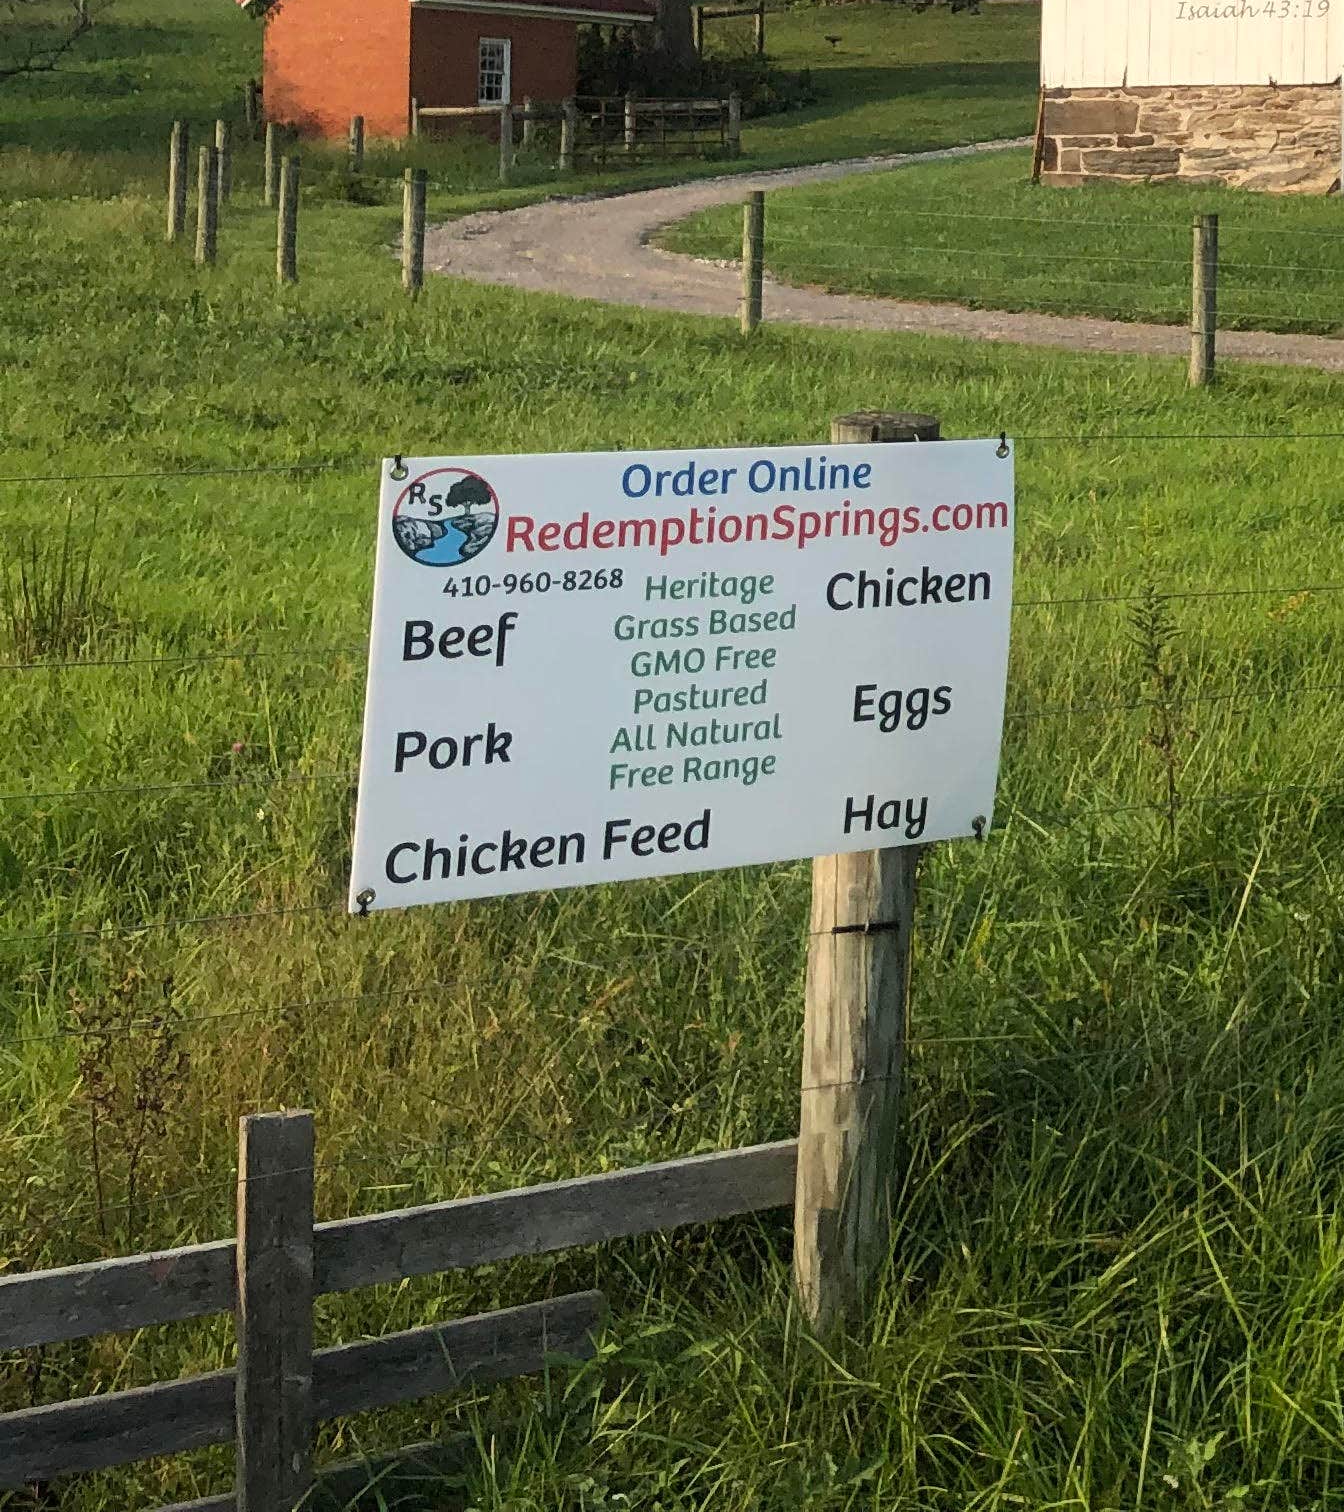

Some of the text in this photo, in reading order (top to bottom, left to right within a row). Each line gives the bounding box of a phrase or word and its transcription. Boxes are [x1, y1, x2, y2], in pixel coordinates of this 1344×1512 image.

[1175, 0, 1331, 21] Isaiah 43:19
[621, 457, 872, 498] Order Online
[505, 498, 1010, 555] RedemptionSprings.com
[442, 567, 624, 598] 410-960-8268
[645, 570, 775, 603] Heritage
[826, 565, 992, 612] Chicken
[402, 611, 519, 667] Beef
[613, 605, 797, 642] Grass Based
[630, 645, 777, 678] GMO Free
[633, 680, 768, 714] Pastured
[852, 682, 953, 733] Eggs
[394, 722, 513, 773] Pork
[609, 713, 783, 754] All Natural
[608, 753, 777, 790] Free Range
[843, 793, 929, 839] Hay
[385, 808, 712, 885] Chicken Feed
